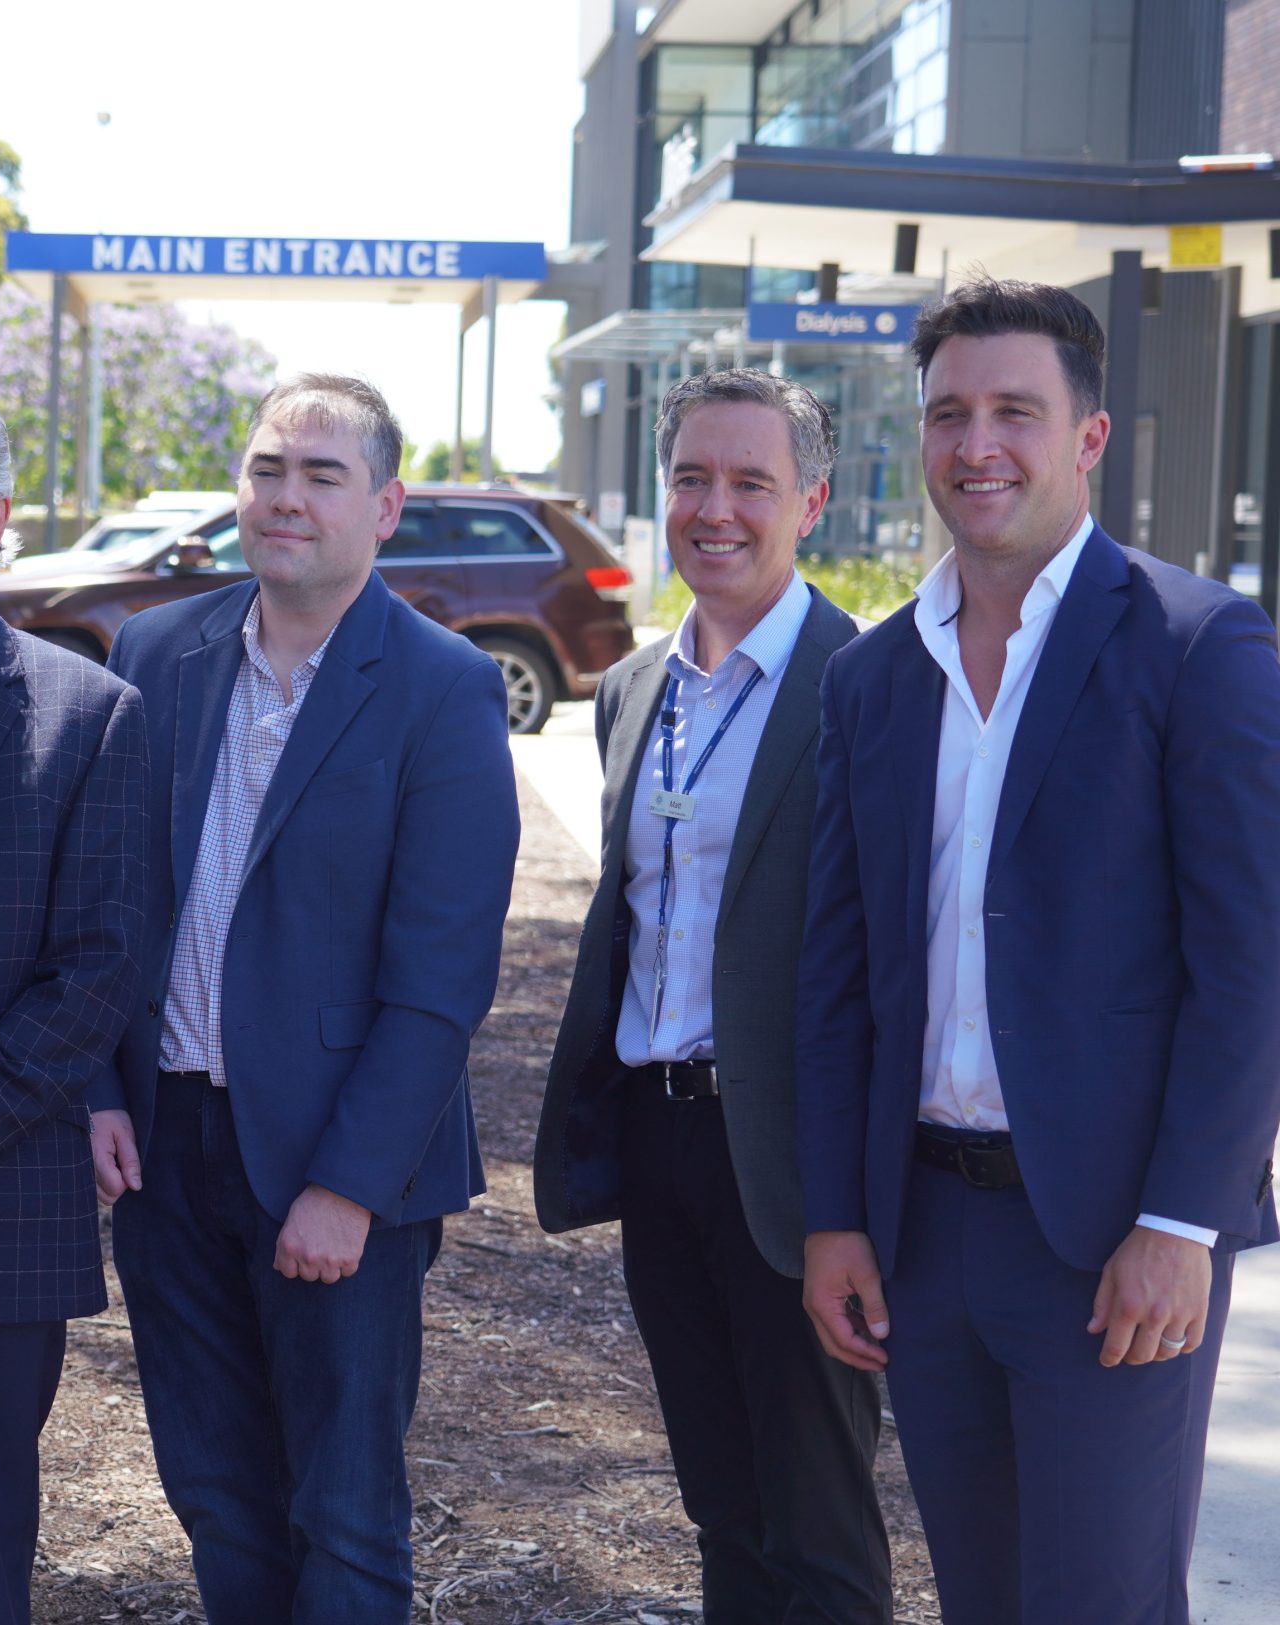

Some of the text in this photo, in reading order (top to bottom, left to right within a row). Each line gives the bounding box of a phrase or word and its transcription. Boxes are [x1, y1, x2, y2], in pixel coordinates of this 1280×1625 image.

[91, 236, 462, 278] MAIN ENTRANCE
[795, 310, 868, 337] Dialysis
